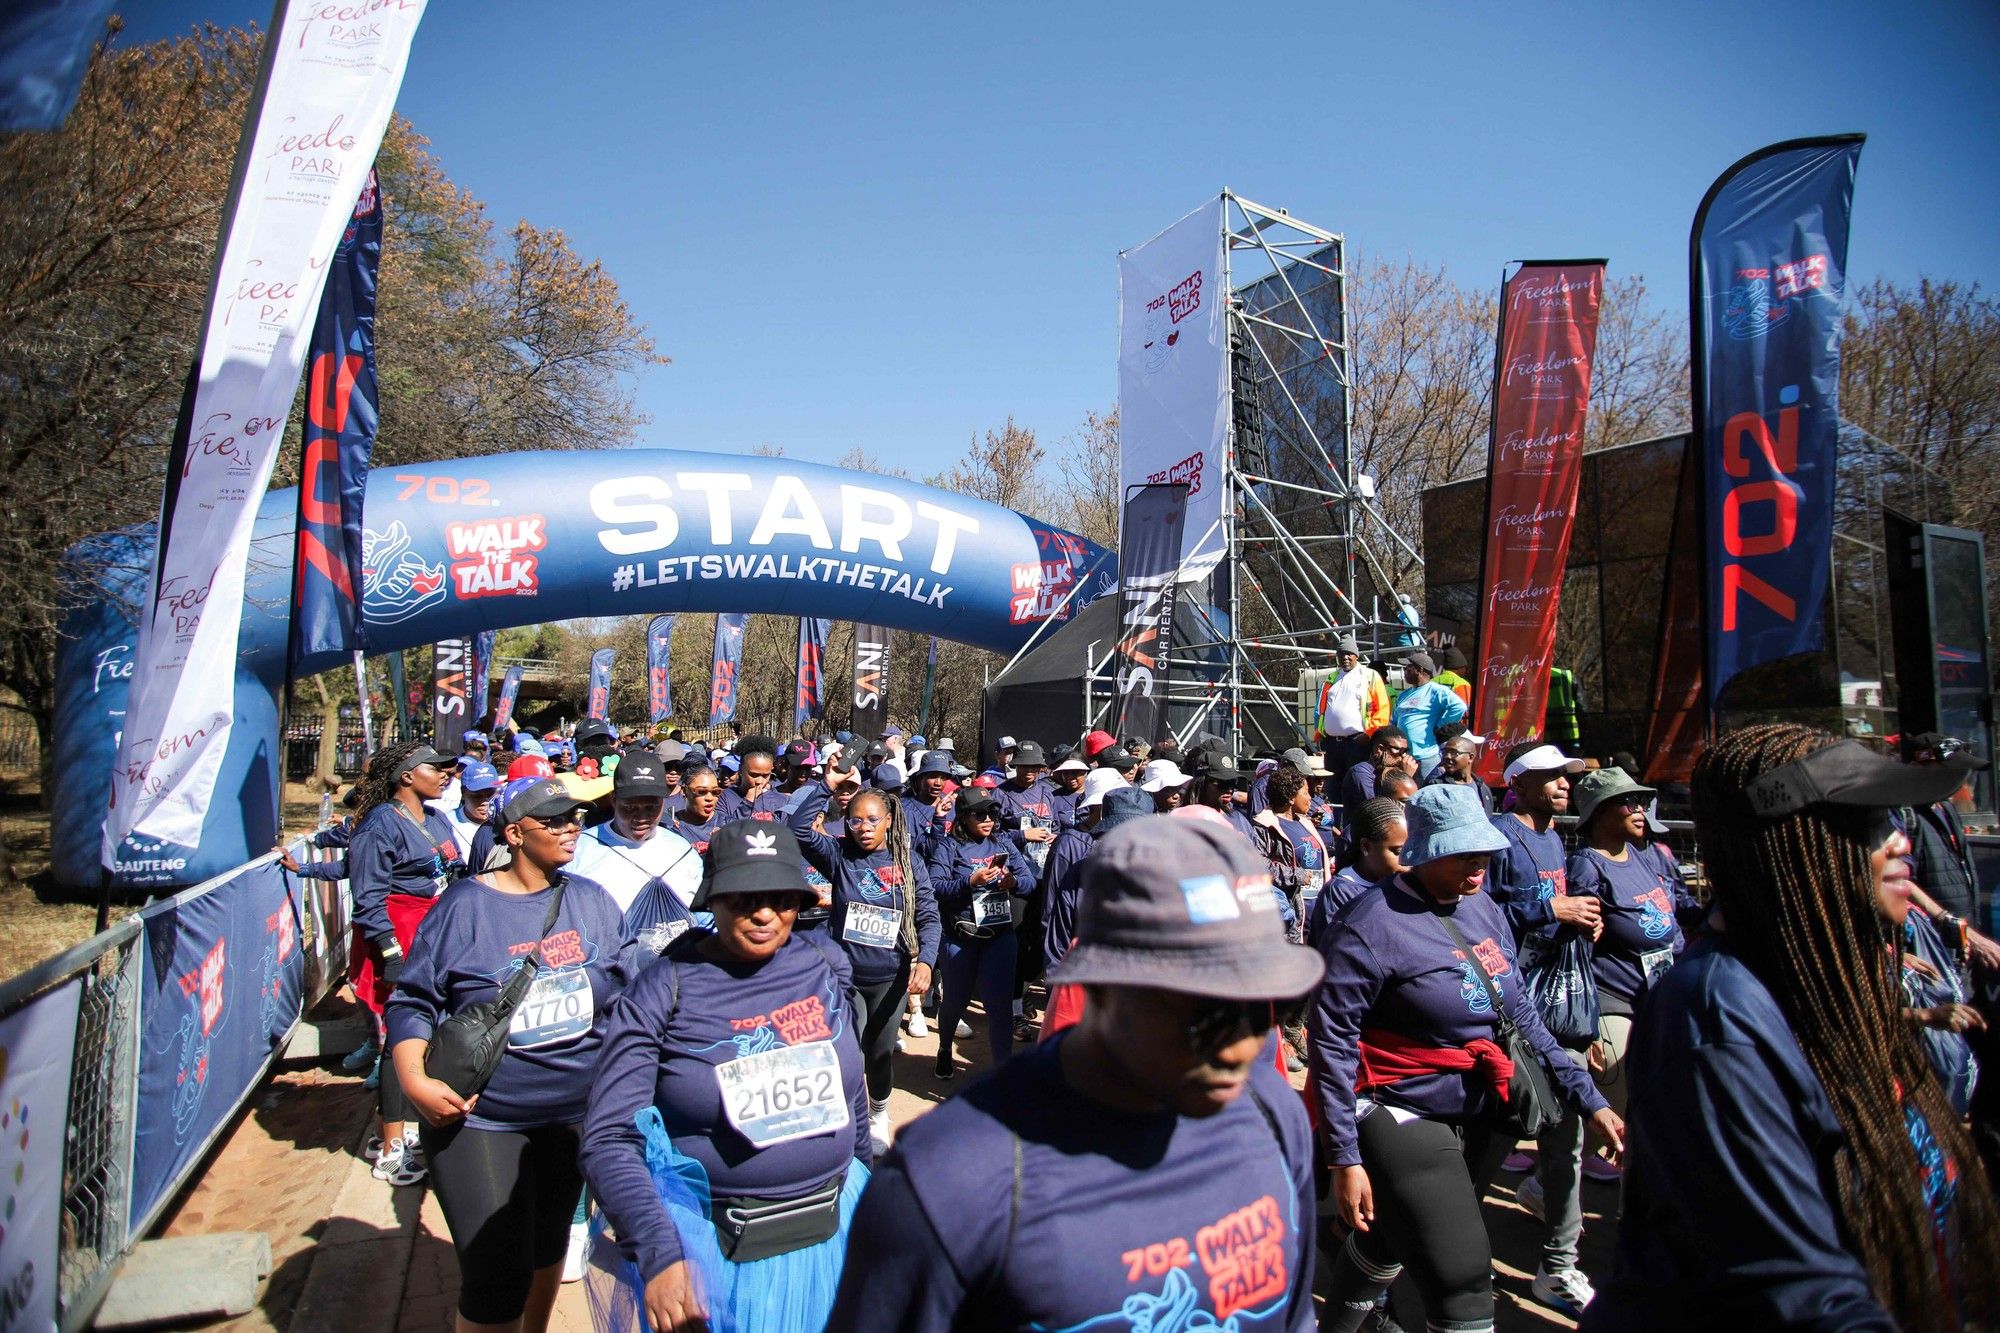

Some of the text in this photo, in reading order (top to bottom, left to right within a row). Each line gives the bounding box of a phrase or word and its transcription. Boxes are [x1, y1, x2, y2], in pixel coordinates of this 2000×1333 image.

[329, 23, 382, 41] PARK
[1513, 274, 1596, 310] Freedom
[1539, 299, 1570, 307] PARK
[1507, 352, 1587, 386] Freedom
[1531, 374, 1562, 384] PARK
[1500, 427, 1577, 461] Freedom
[1523, 451, 1554, 459] PARK
[452, 519, 542, 554] WALK
[589, 472, 980, 575] START
[1494, 503, 1567, 536] Freedom
[1516, 526, 1545, 535] PARK
[481, 550, 512, 566] THE
[456, 560, 532, 594] TALK
[612, 554, 954, 609] #LETSWALKTHETALK
[1014, 562, 1071, 589] WALK
[1033, 584, 1052, 597] THE
[1511, 602, 1540, 611] PARK
[1117, 577, 1162, 698] SANI
[1157, 580, 1175, 670] CAR RENTAL
[464, 641, 472, 677] RENTAL
[881, 644, 891, 695] CAR RENTAL
[855, 642, 883, 711] SANI
[543, 932, 581, 952] WALK
[853, 916, 891, 936] 1008
[549, 950, 585, 967] TALK
[517, 994, 580, 1029] 1770
[775, 998, 820, 1025] WALK
[785, 1019, 827, 1042] TALK
[735, 1070, 835, 1121] 21652
[1201, 1203, 1280, 1269] WALK
[1216, 1253, 1281, 1309] TALK
